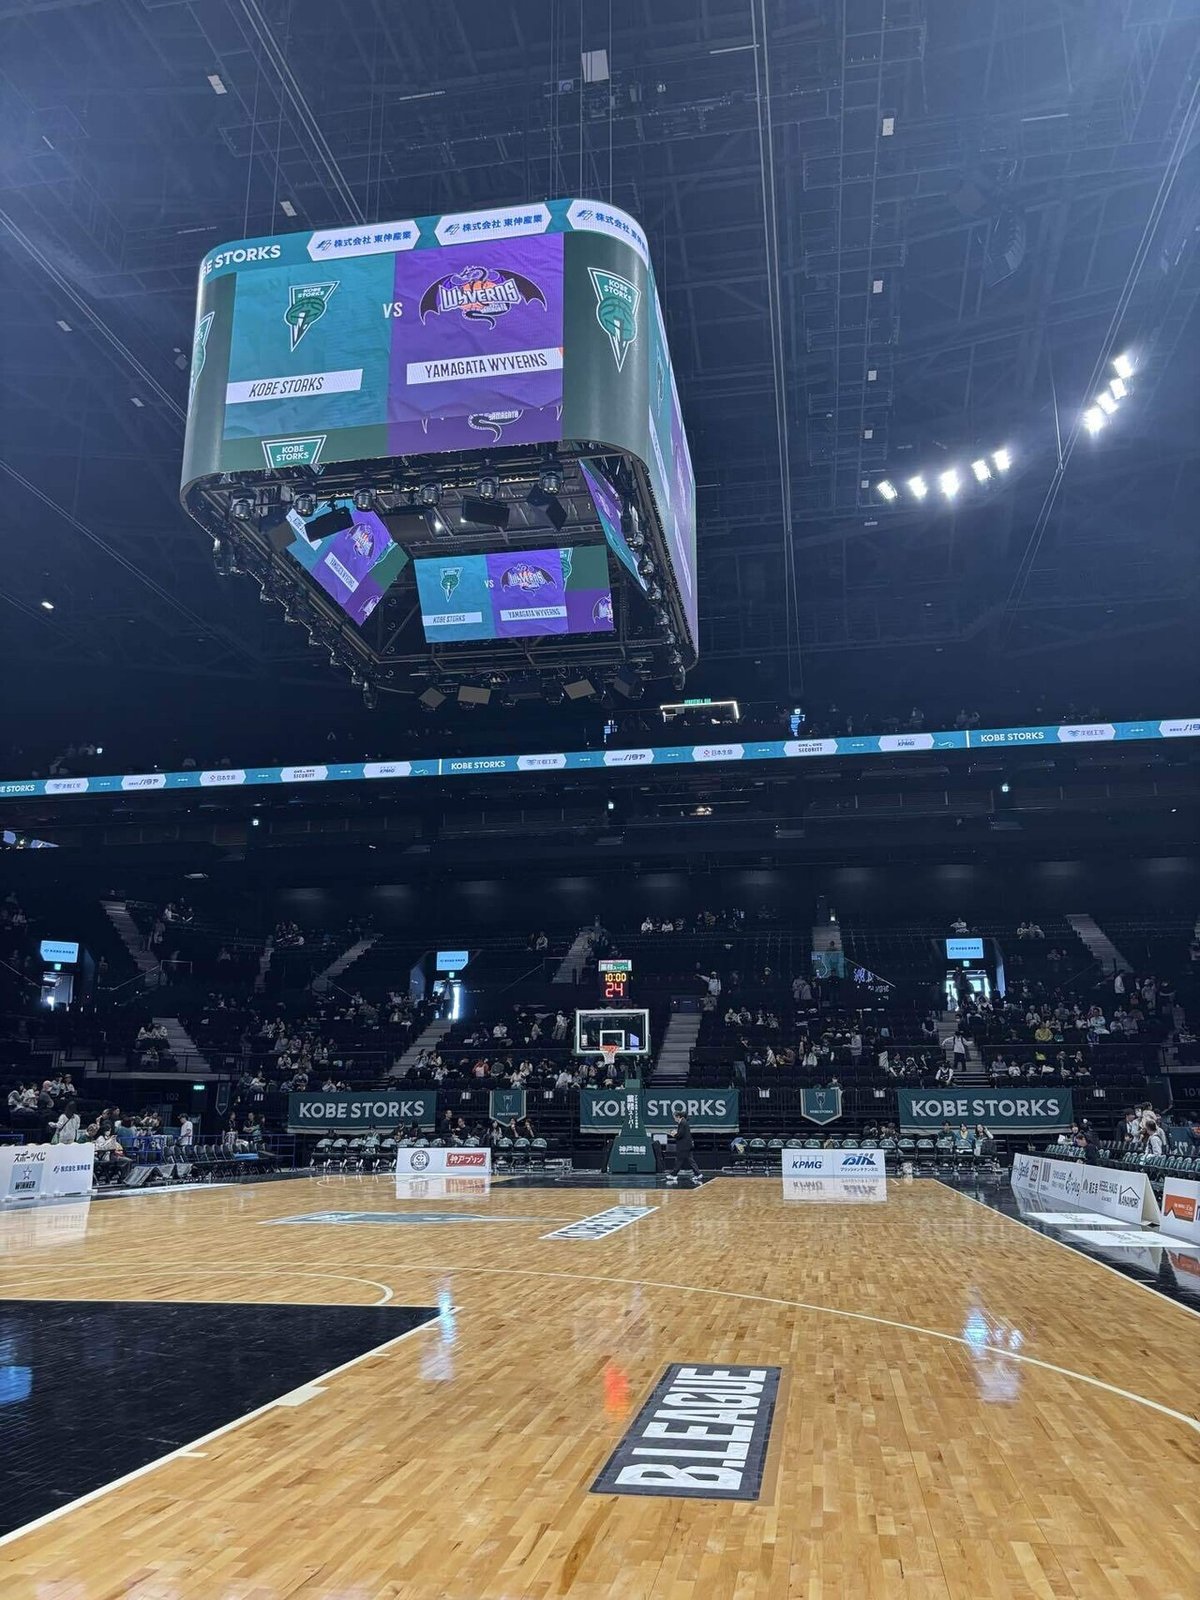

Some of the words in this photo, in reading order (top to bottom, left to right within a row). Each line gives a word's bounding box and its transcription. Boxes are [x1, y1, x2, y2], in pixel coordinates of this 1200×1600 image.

[462, 219, 501, 233] 株式会社
[333, 235, 372, 248] 株式会社
[214, 244, 281, 269] STORKS
[608, 279, 629, 293] KOBE
[603, 286, 633, 303] STORKS
[383, 302, 403, 319] VS
[425, 361, 487, 379] YAMAGATA
[489, 353, 548, 373] WYVERNS
[249, 382, 280, 399] KOBE
[280, 377, 324, 394] STORKS
[276, 451, 309, 462] STORKS
[282, 445, 305, 454] KOBE
[981, 733, 1006, 743] KOBE
[1007, 731, 1045, 741] STORKS
[451, 762, 473, 771] KOBE
[473, 760, 506, 769] STORKS
[6, 784, 35, 793] STORKS
[605, 973, 627, 982] 10:00
[605, 982, 624, 998] 24
[299, 1102, 347, 1119] KOBE
[350, 1100, 425, 1118] STORKS
[647, 1099, 727, 1117] STORKS
[911, 1099, 968, 1118] KOBE
[972, 1099, 1060, 1117] STORKS
[13, 1150, 47, 1163] スポーツくじ
[449, 1155, 484, 1164] 神戸プリン
[791, 1160, 823, 1169] KPMG
[15, 1180, 36, 1190] WINNER
[614, 1367, 767, 1491] B.LEAGUE
